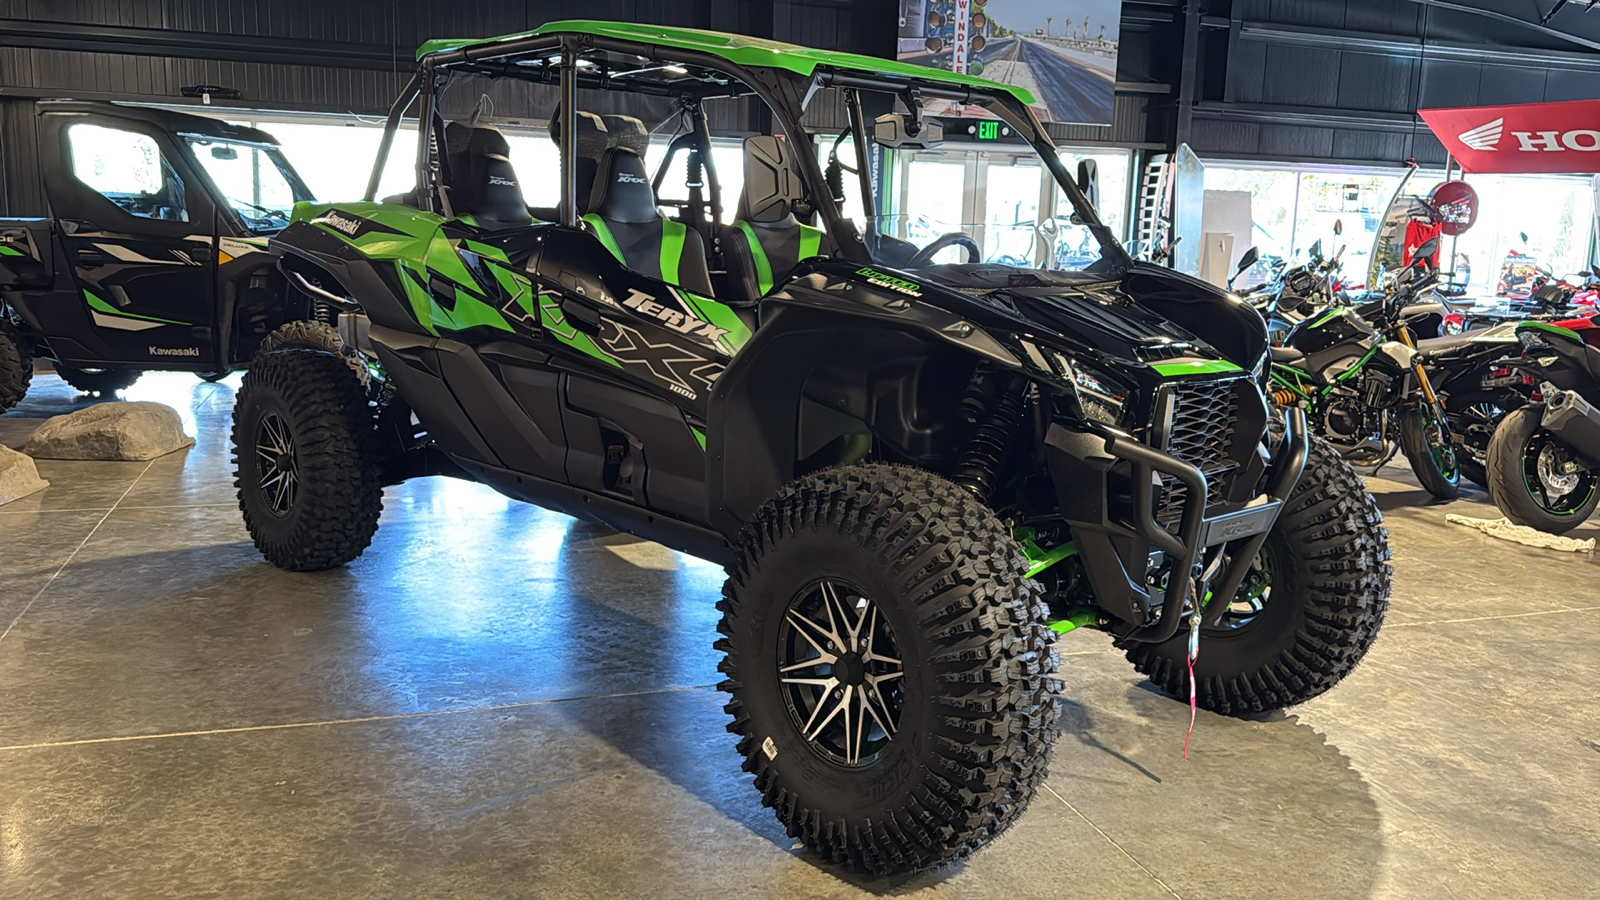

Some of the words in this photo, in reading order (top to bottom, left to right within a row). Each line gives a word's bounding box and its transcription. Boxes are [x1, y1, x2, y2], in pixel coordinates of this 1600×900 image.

[978, 121, 999, 140] EXIT
[1510, 129, 1600, 152] HO
[871, 135, 881, 197] Kawasak
[325, 210, 362, 236] Kawasaki
[866, 278, 923, 297] EDITION
[148, 346, 200, 357] Kawasaki
[669, 384, 698, 401] 1000
